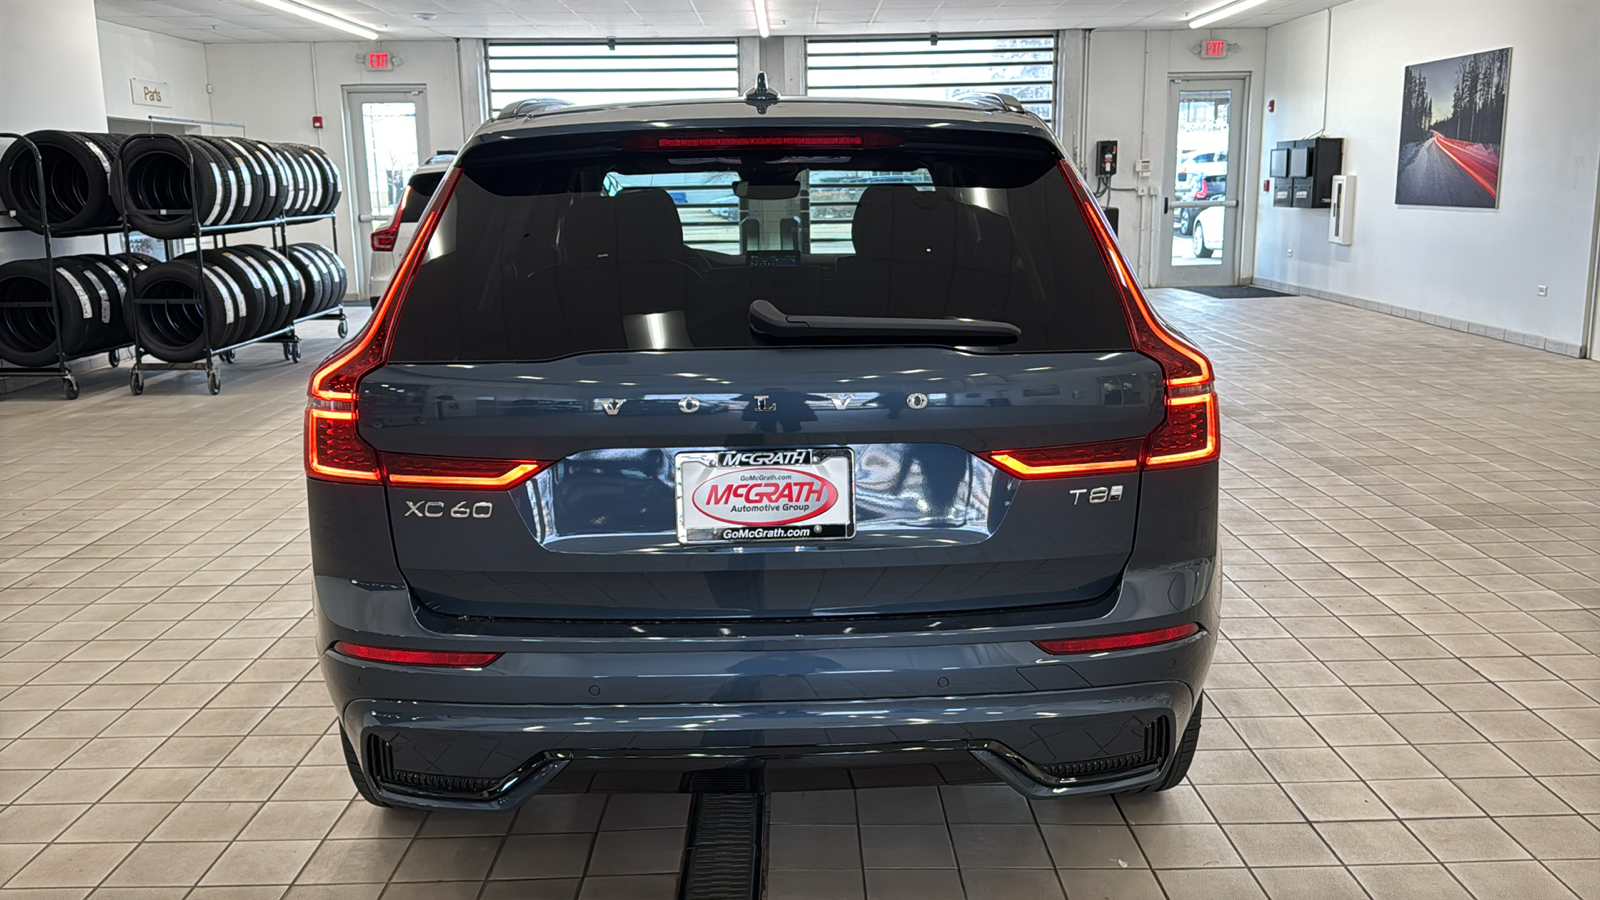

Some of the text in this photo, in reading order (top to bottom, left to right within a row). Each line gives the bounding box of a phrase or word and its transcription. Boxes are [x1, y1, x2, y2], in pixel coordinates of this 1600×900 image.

[1205, 40, 1225, 55] EXIT
[369, 52, 388, 68] EXIT
[143, 86, 162, 103] Parts
[600, 392, 928, 416] VOLVO
[740, 474, 792, 483] GoMcGrath.com
[1069, 486, 1108, 505] T8
[730, 502, 810, 513] Automotive Group
[722, 528, 810, 540] GoMcGrath.com
